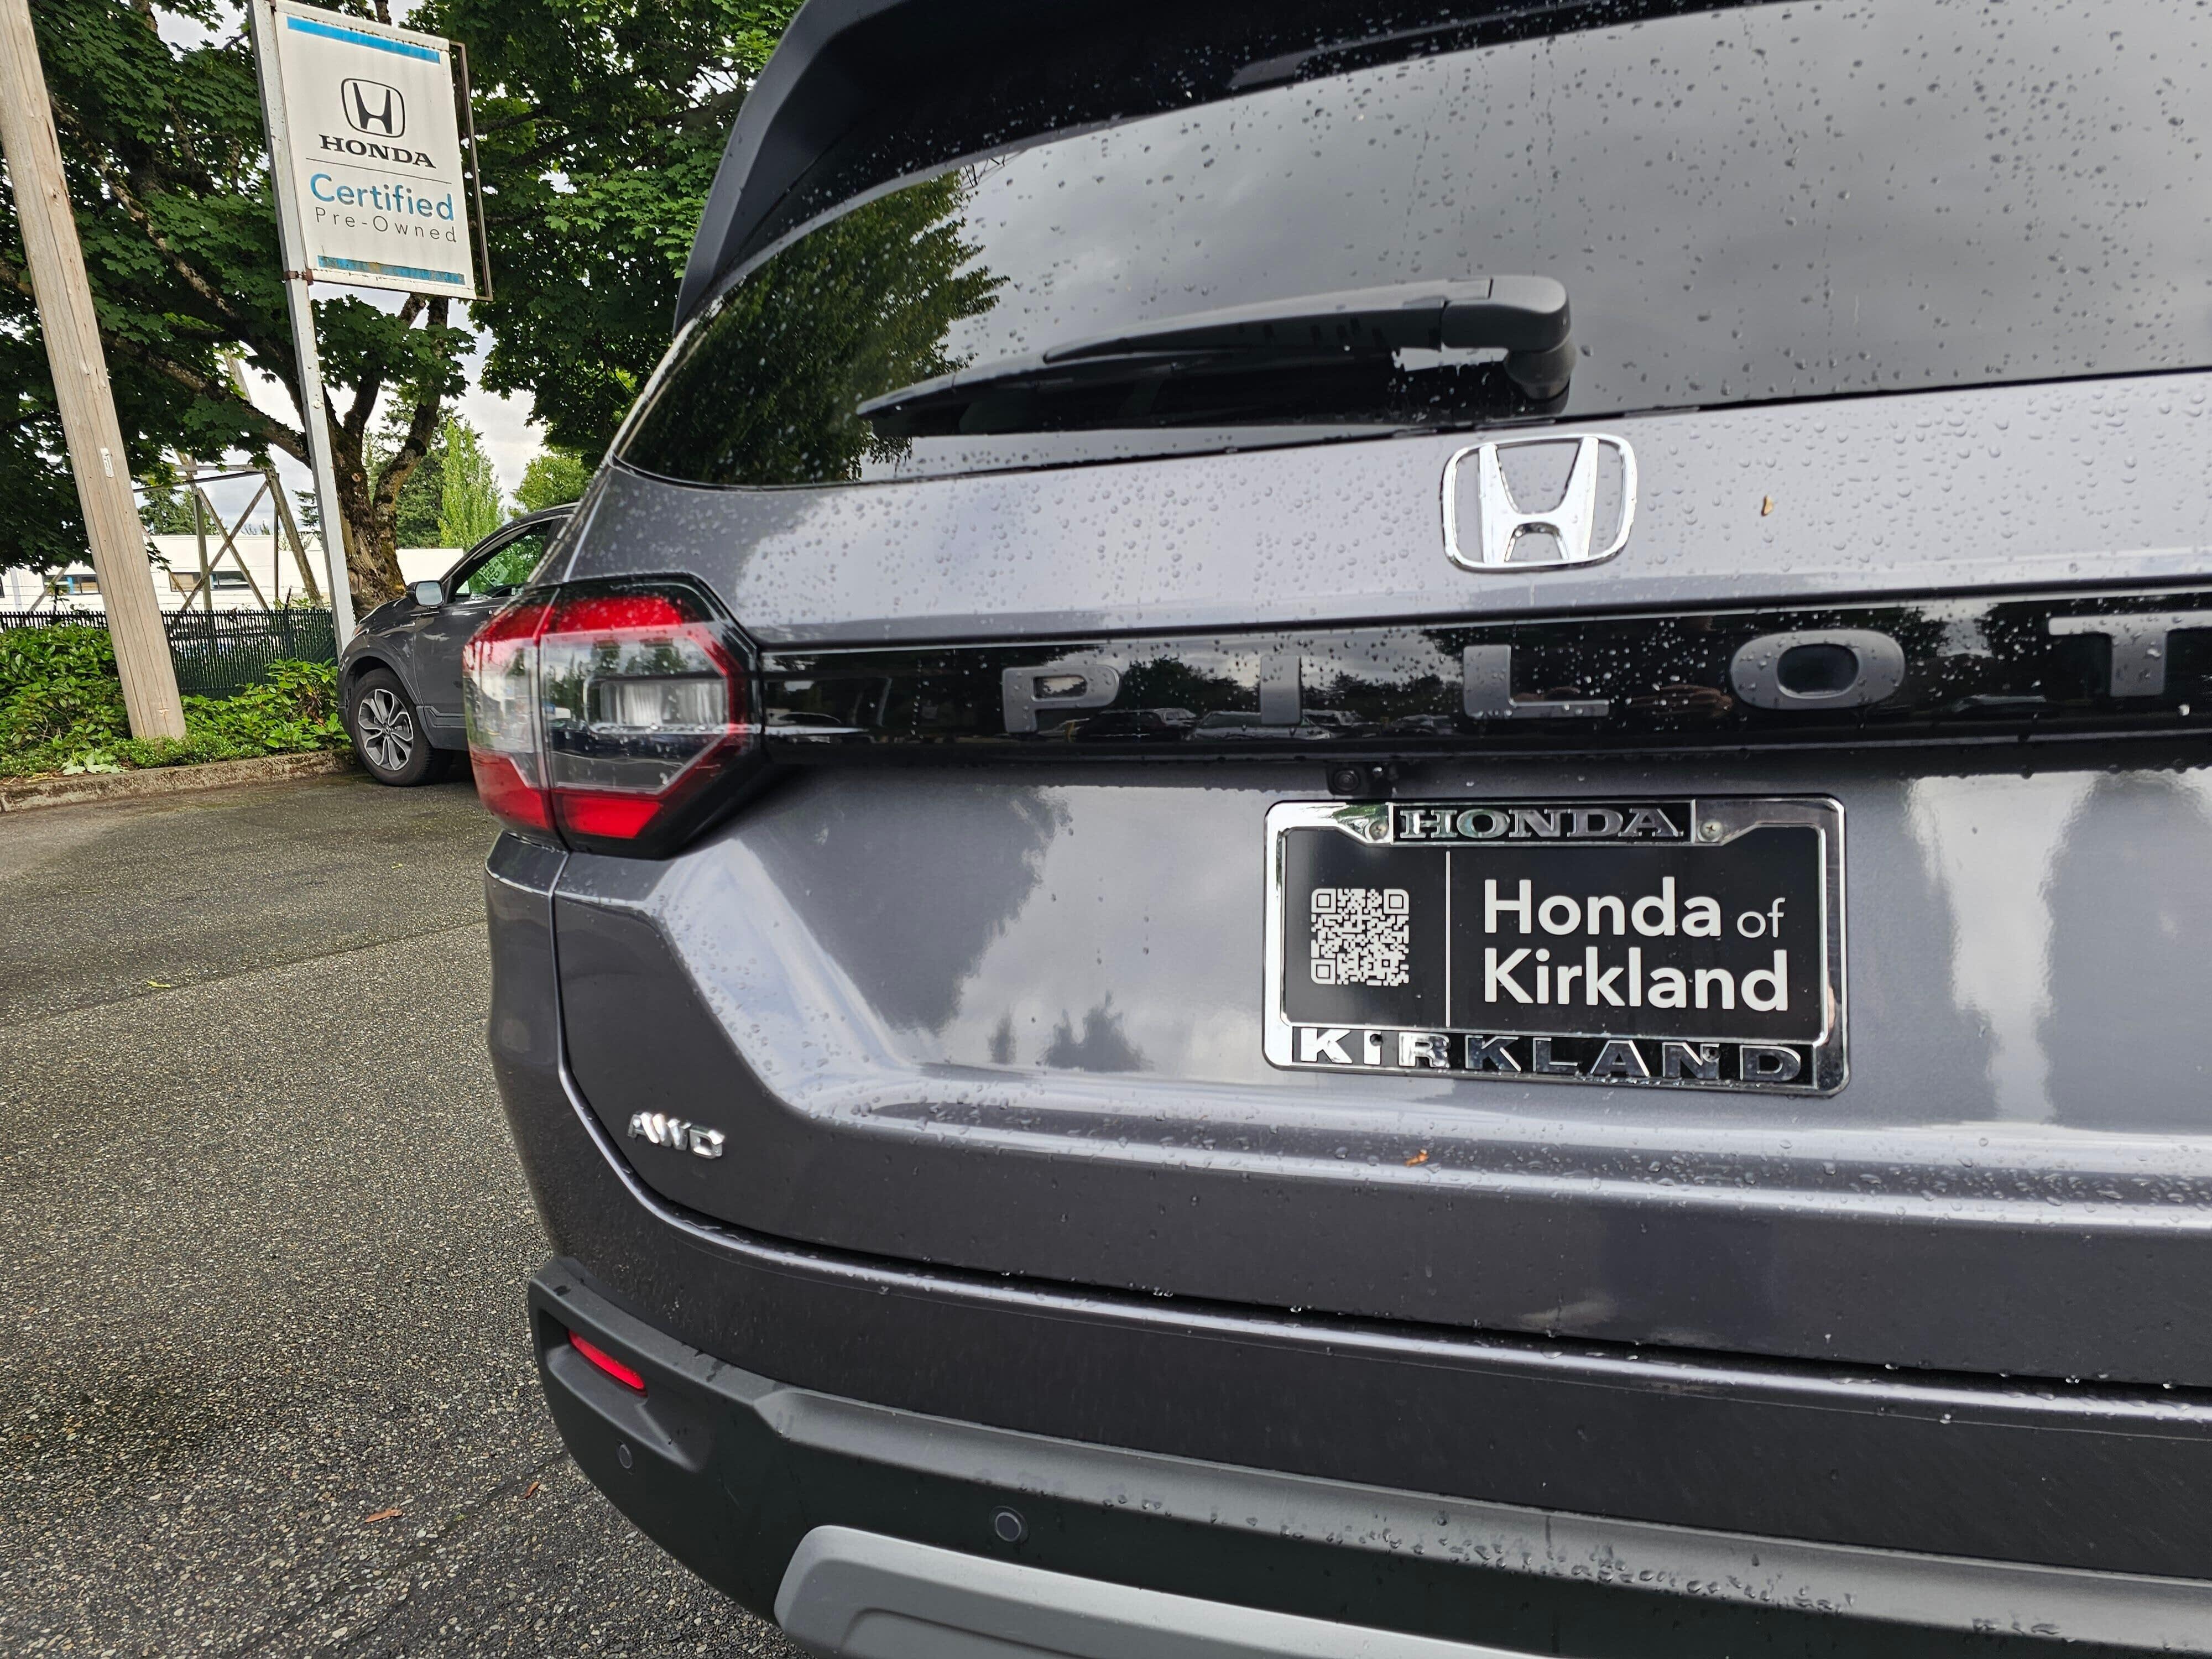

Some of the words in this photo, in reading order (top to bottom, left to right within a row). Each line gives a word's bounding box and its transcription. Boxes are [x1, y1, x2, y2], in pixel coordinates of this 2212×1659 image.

[319, 134, 437, 169] HONDA
[309, 173, 455, 221] Certified
[314, 206, 457, 243] Pre-Owned
[1001, 611, 2212, 734] PILOT
[1399, 807, 1684, 840] HONDA
[1483, 876, 1721, 937] Honda
[1736, 897, 1786, 939] of
[1483, 946, 1788, 1013] Kirkland
[1298, 1027, 1802, 1082] KIRKLAND
[627, 1110, 726, 1160] AWD
